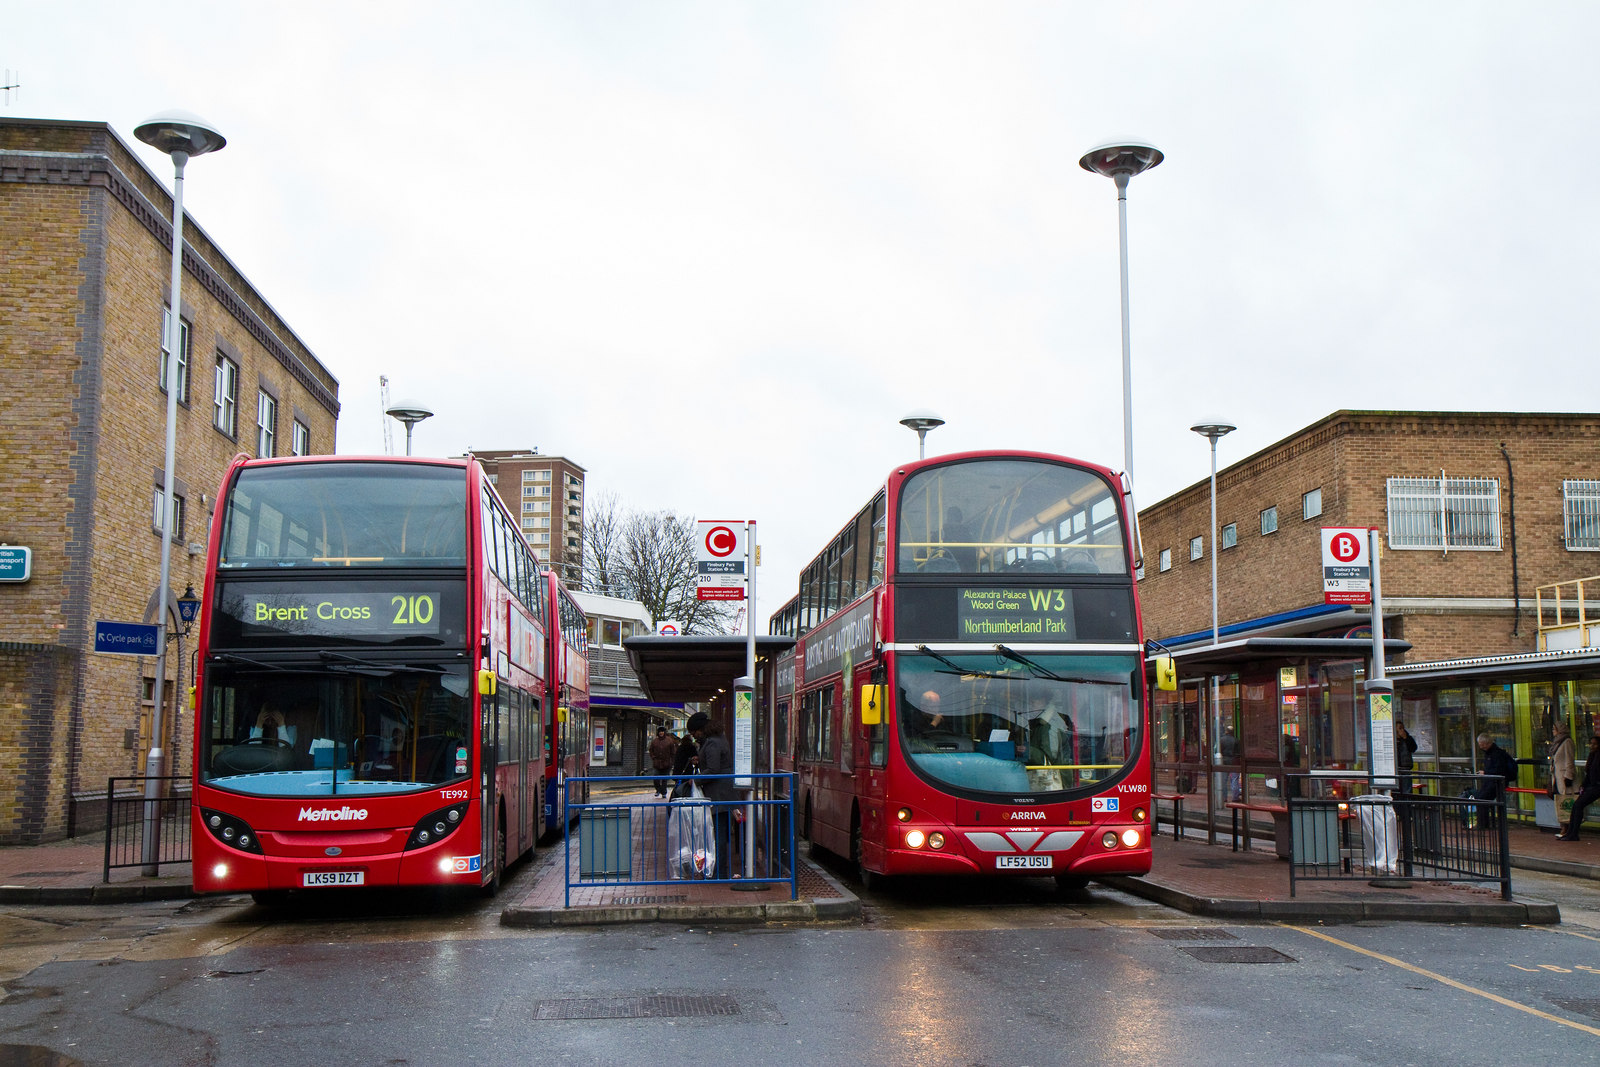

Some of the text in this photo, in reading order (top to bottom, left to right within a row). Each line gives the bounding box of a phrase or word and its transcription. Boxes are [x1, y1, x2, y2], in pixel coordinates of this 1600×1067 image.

[709, 529, 730, 554] C
[1339, 537, 1354, 557] B
[963, 589, 1027, 599] Alexandra Palace
[1028, 588, 1066, 611] W3
[391, 595, 434, 624] 210
[971, 600, 1020, 610] Wood Green
[255, 602, 371, 621] Brent Cross
[965, 618, 1067, 634] Northumberland Park
[106, 633, 142, 645] Cycle park
[440, 790, 468, 799] TE992
[1117, 784, 1147, 793] VLW80
[298, 806, 368, 821] Metroline
[1010, 811, 1047, 820] ARRIVA
[1000, 857, 1049, 867] LF52 USU
[307, 872, 359, 884] LK59 DZT
